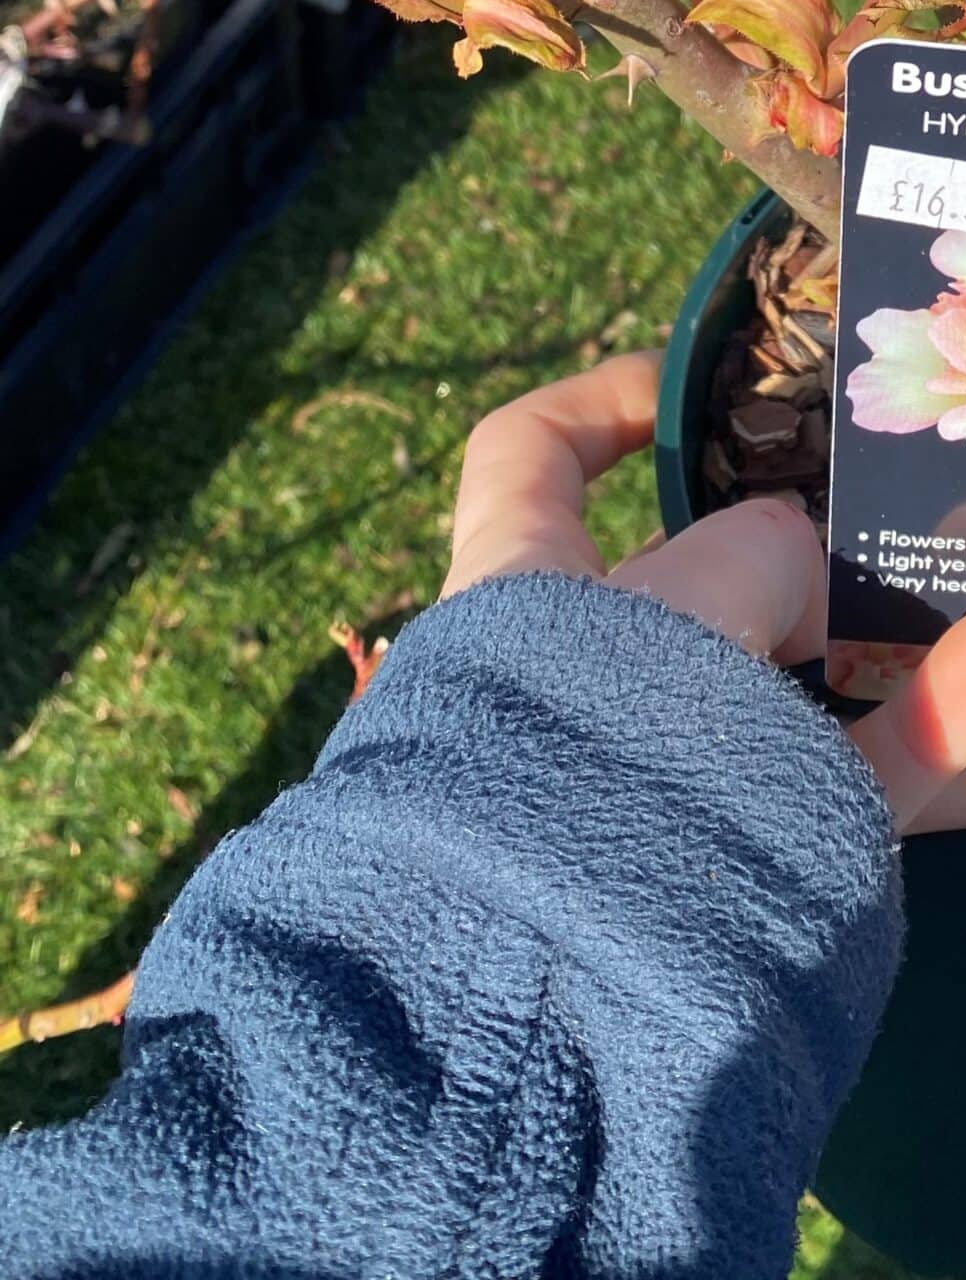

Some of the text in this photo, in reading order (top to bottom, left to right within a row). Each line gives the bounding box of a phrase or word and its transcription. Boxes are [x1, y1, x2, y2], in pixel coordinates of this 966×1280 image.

[878, 530, 966, 551] Flowers
[877, 551, 934, 571] Light
[877, 573, 926, 593] Very
